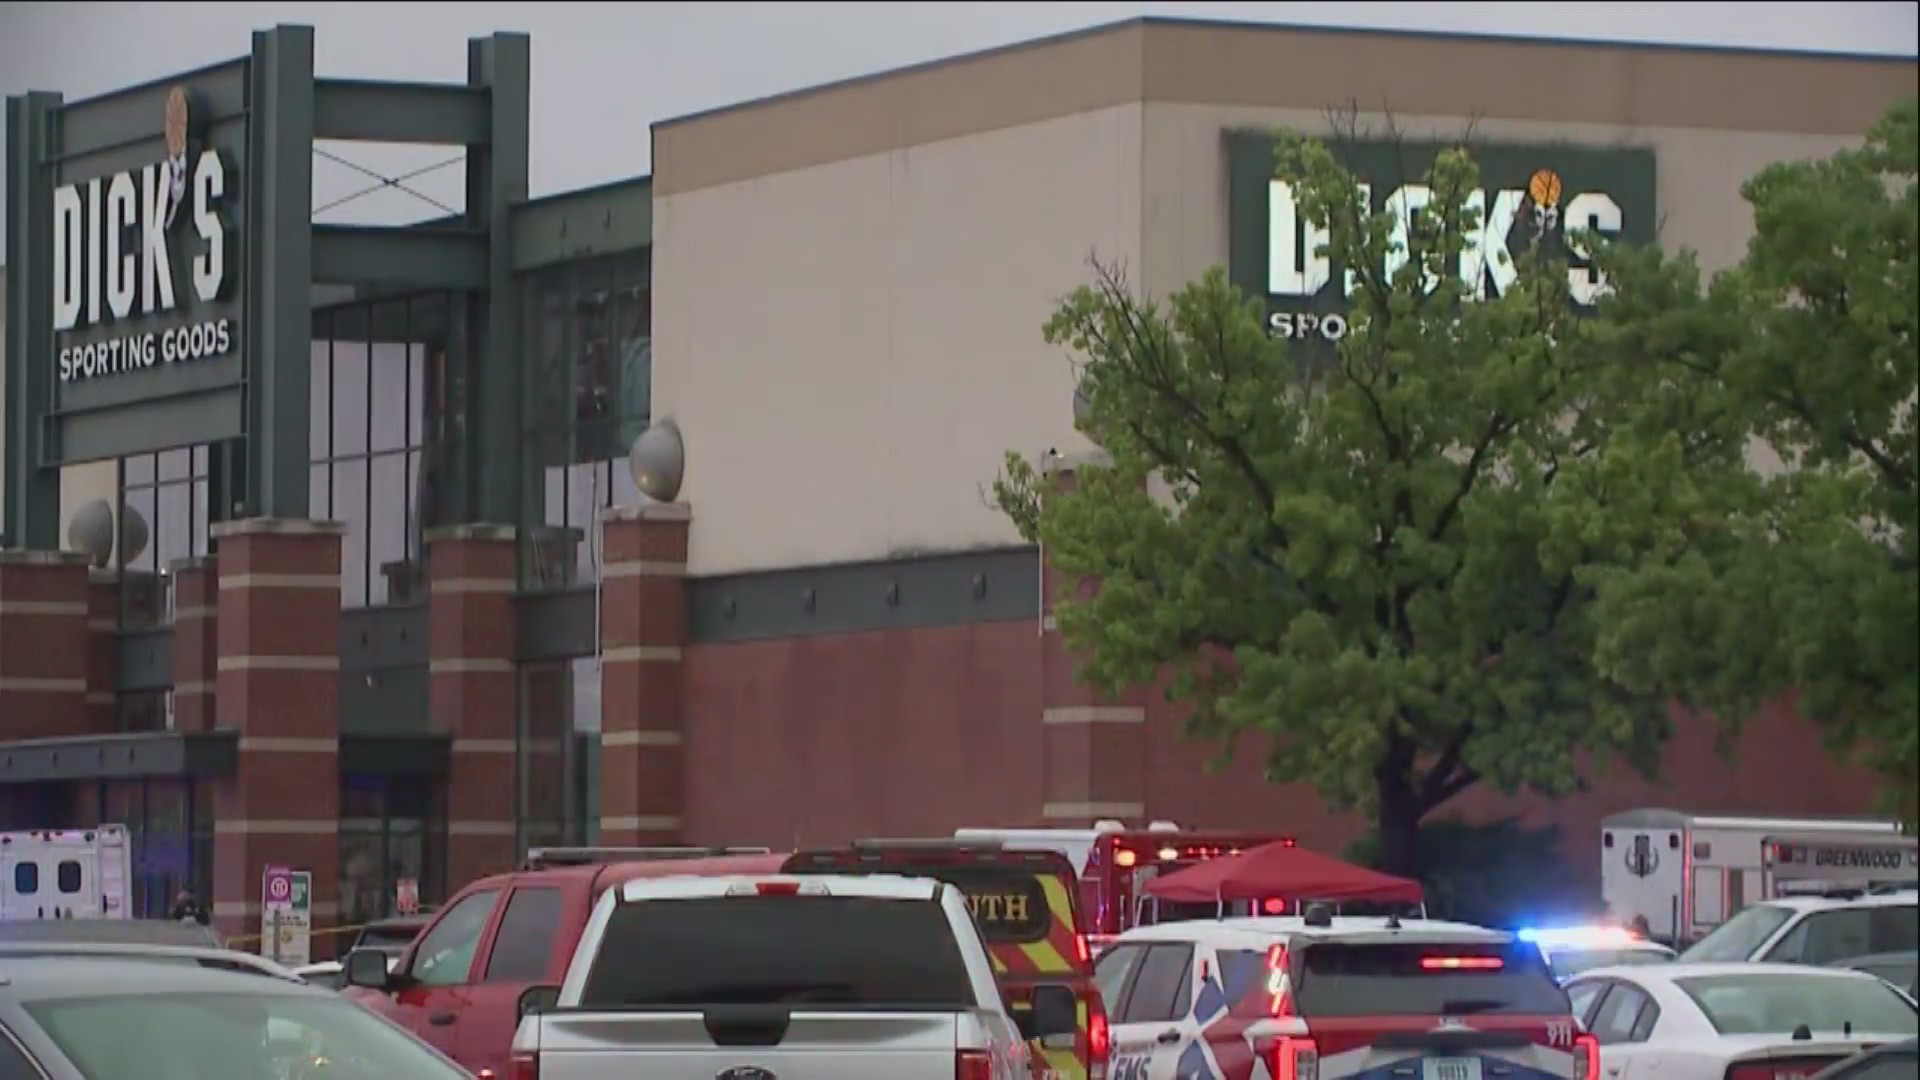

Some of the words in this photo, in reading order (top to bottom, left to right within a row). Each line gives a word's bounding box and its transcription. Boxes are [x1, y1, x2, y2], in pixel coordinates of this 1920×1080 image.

[54, 86, 224, 330] DICK'S
[59, 333, 154, 381] SPORTING
[161, 318, 230, 362] GOODS
[1815, 848, 1901, 869] GREENWOOD
[1547, 1021, 1572, 1045] 911
[1114, 1056, 1152, 1080] EMS
